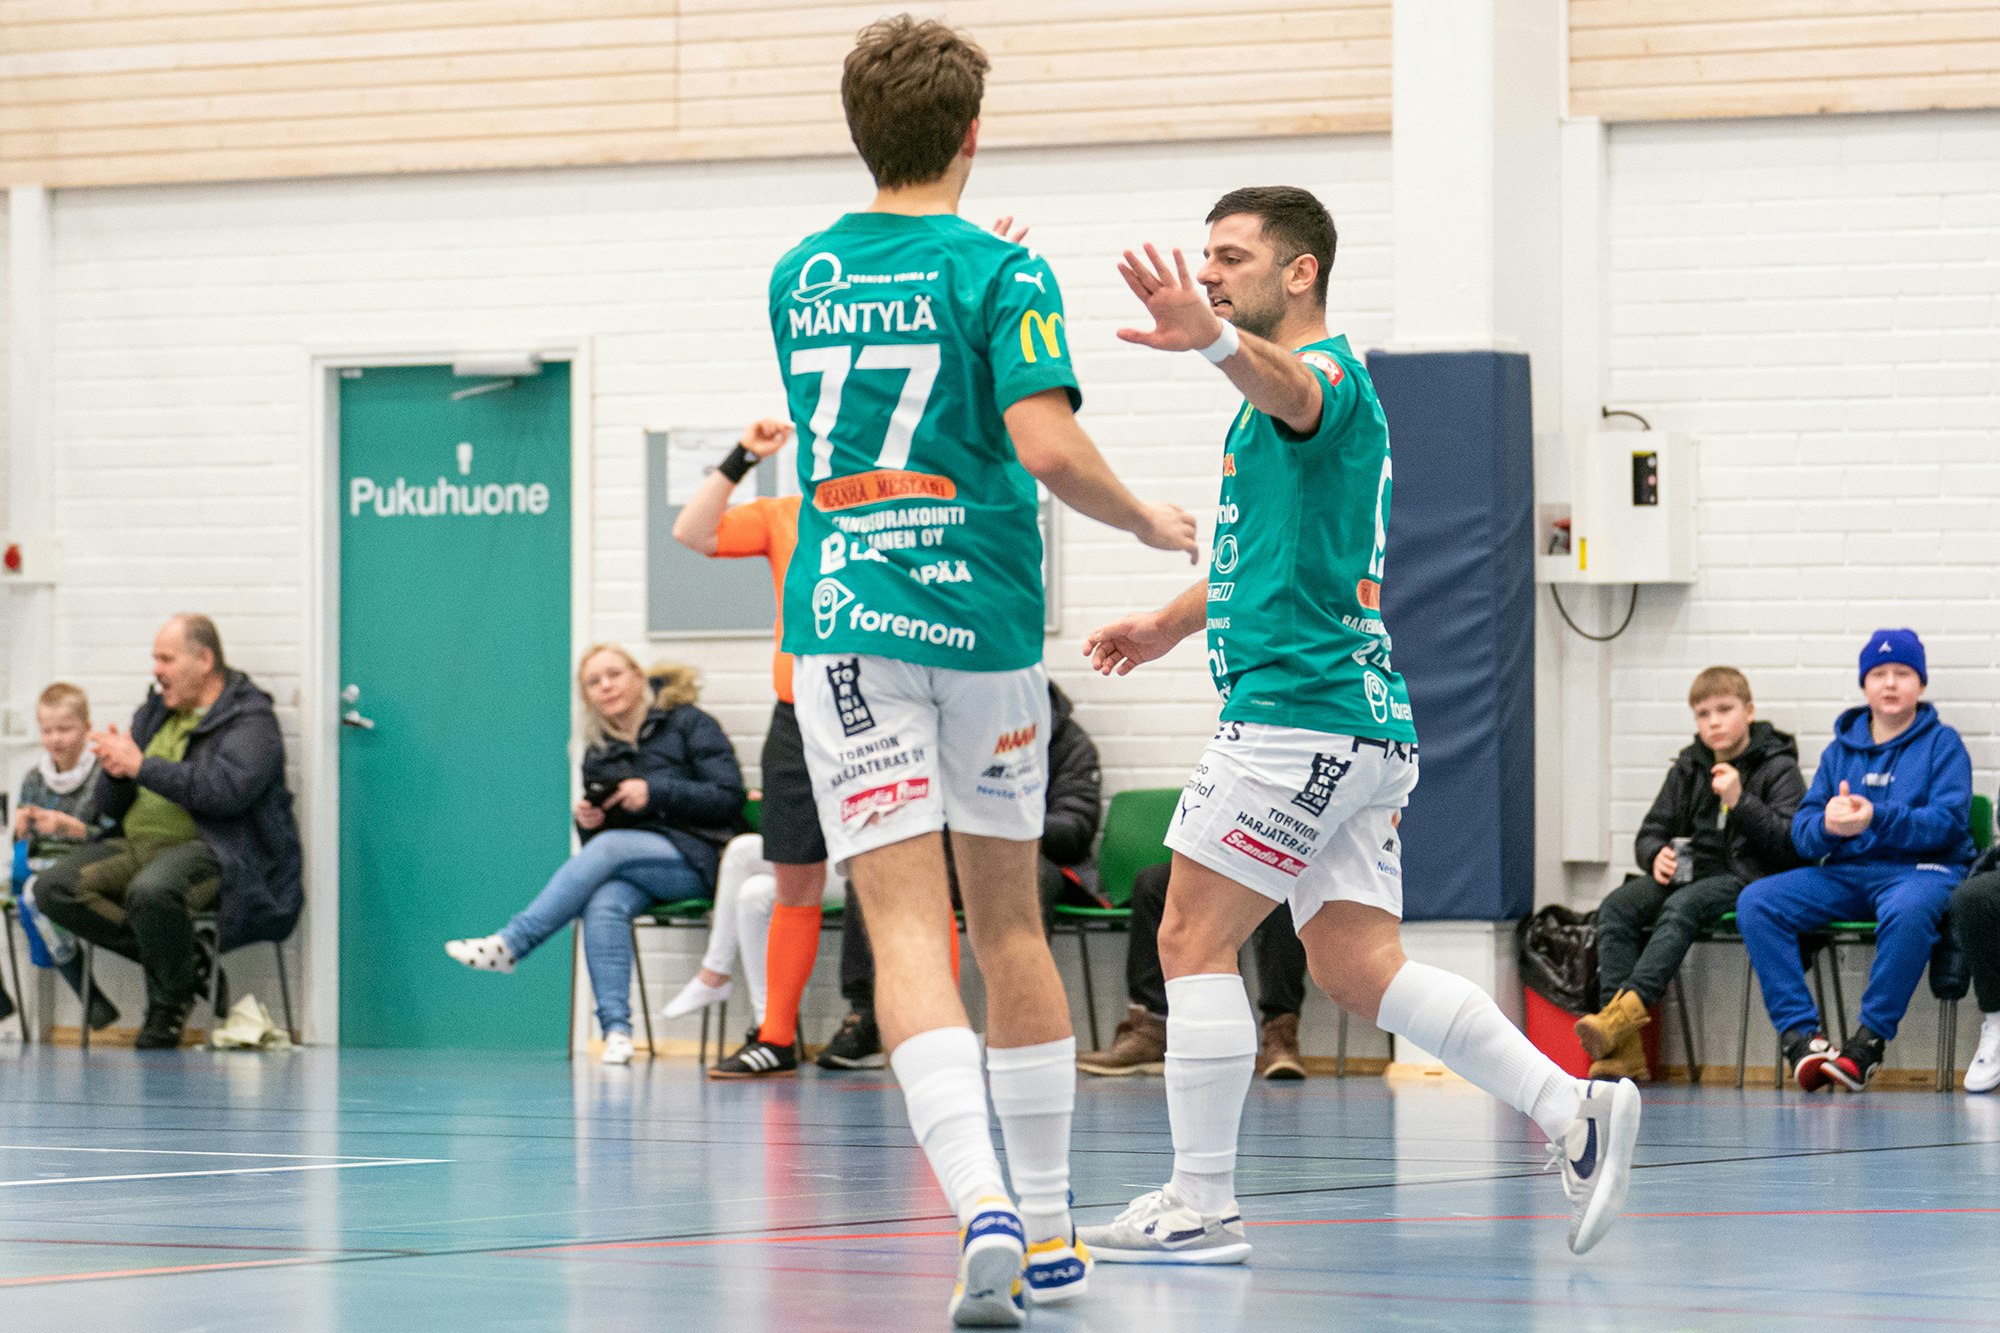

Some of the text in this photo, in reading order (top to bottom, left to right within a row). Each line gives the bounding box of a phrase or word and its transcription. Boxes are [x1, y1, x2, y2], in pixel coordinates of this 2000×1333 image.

[788, 294, 938, 339] MÄNTYLÄ
[790, 342, 942, 482] 77
[350, 476, 550, 517] Pukuhuone
[921, 527, 945, 548] OY
[850, 602, 977, 651] forenom
[838, 736, 900, 762] TORNION
[1225, 830, 1280, 866] Scandia
